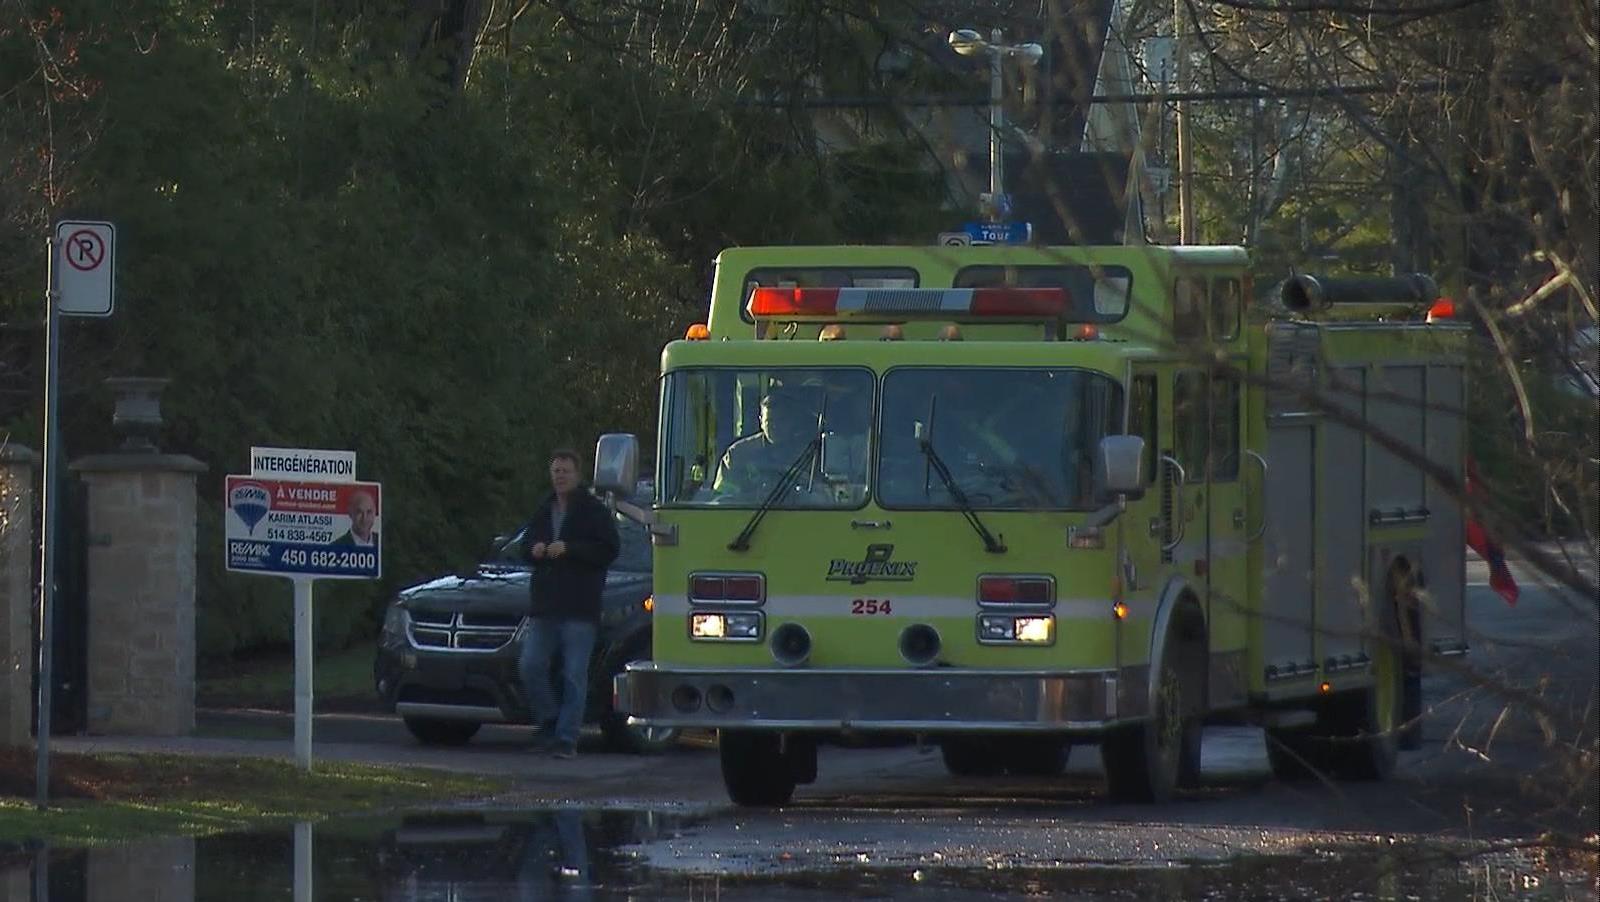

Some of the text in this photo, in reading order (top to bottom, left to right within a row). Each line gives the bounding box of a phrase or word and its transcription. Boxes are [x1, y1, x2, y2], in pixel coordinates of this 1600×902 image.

[982, 230, 1010, 241] Tour
[253, 454, 353, 475] INTERGÉNÉRATION
[276, 484, 337, 502] À VENDRE
[268, 512, 333, 526] KARIM ATLASSI
[267, 528, 333, 542] 514 838-4567
[231, 541, 270, 556] RE/MAX
[281, 549, 376, 569] 450 682-2000
[827, 559, 917, 577] PHOENIX
[852, 599, 892, 615] 254
